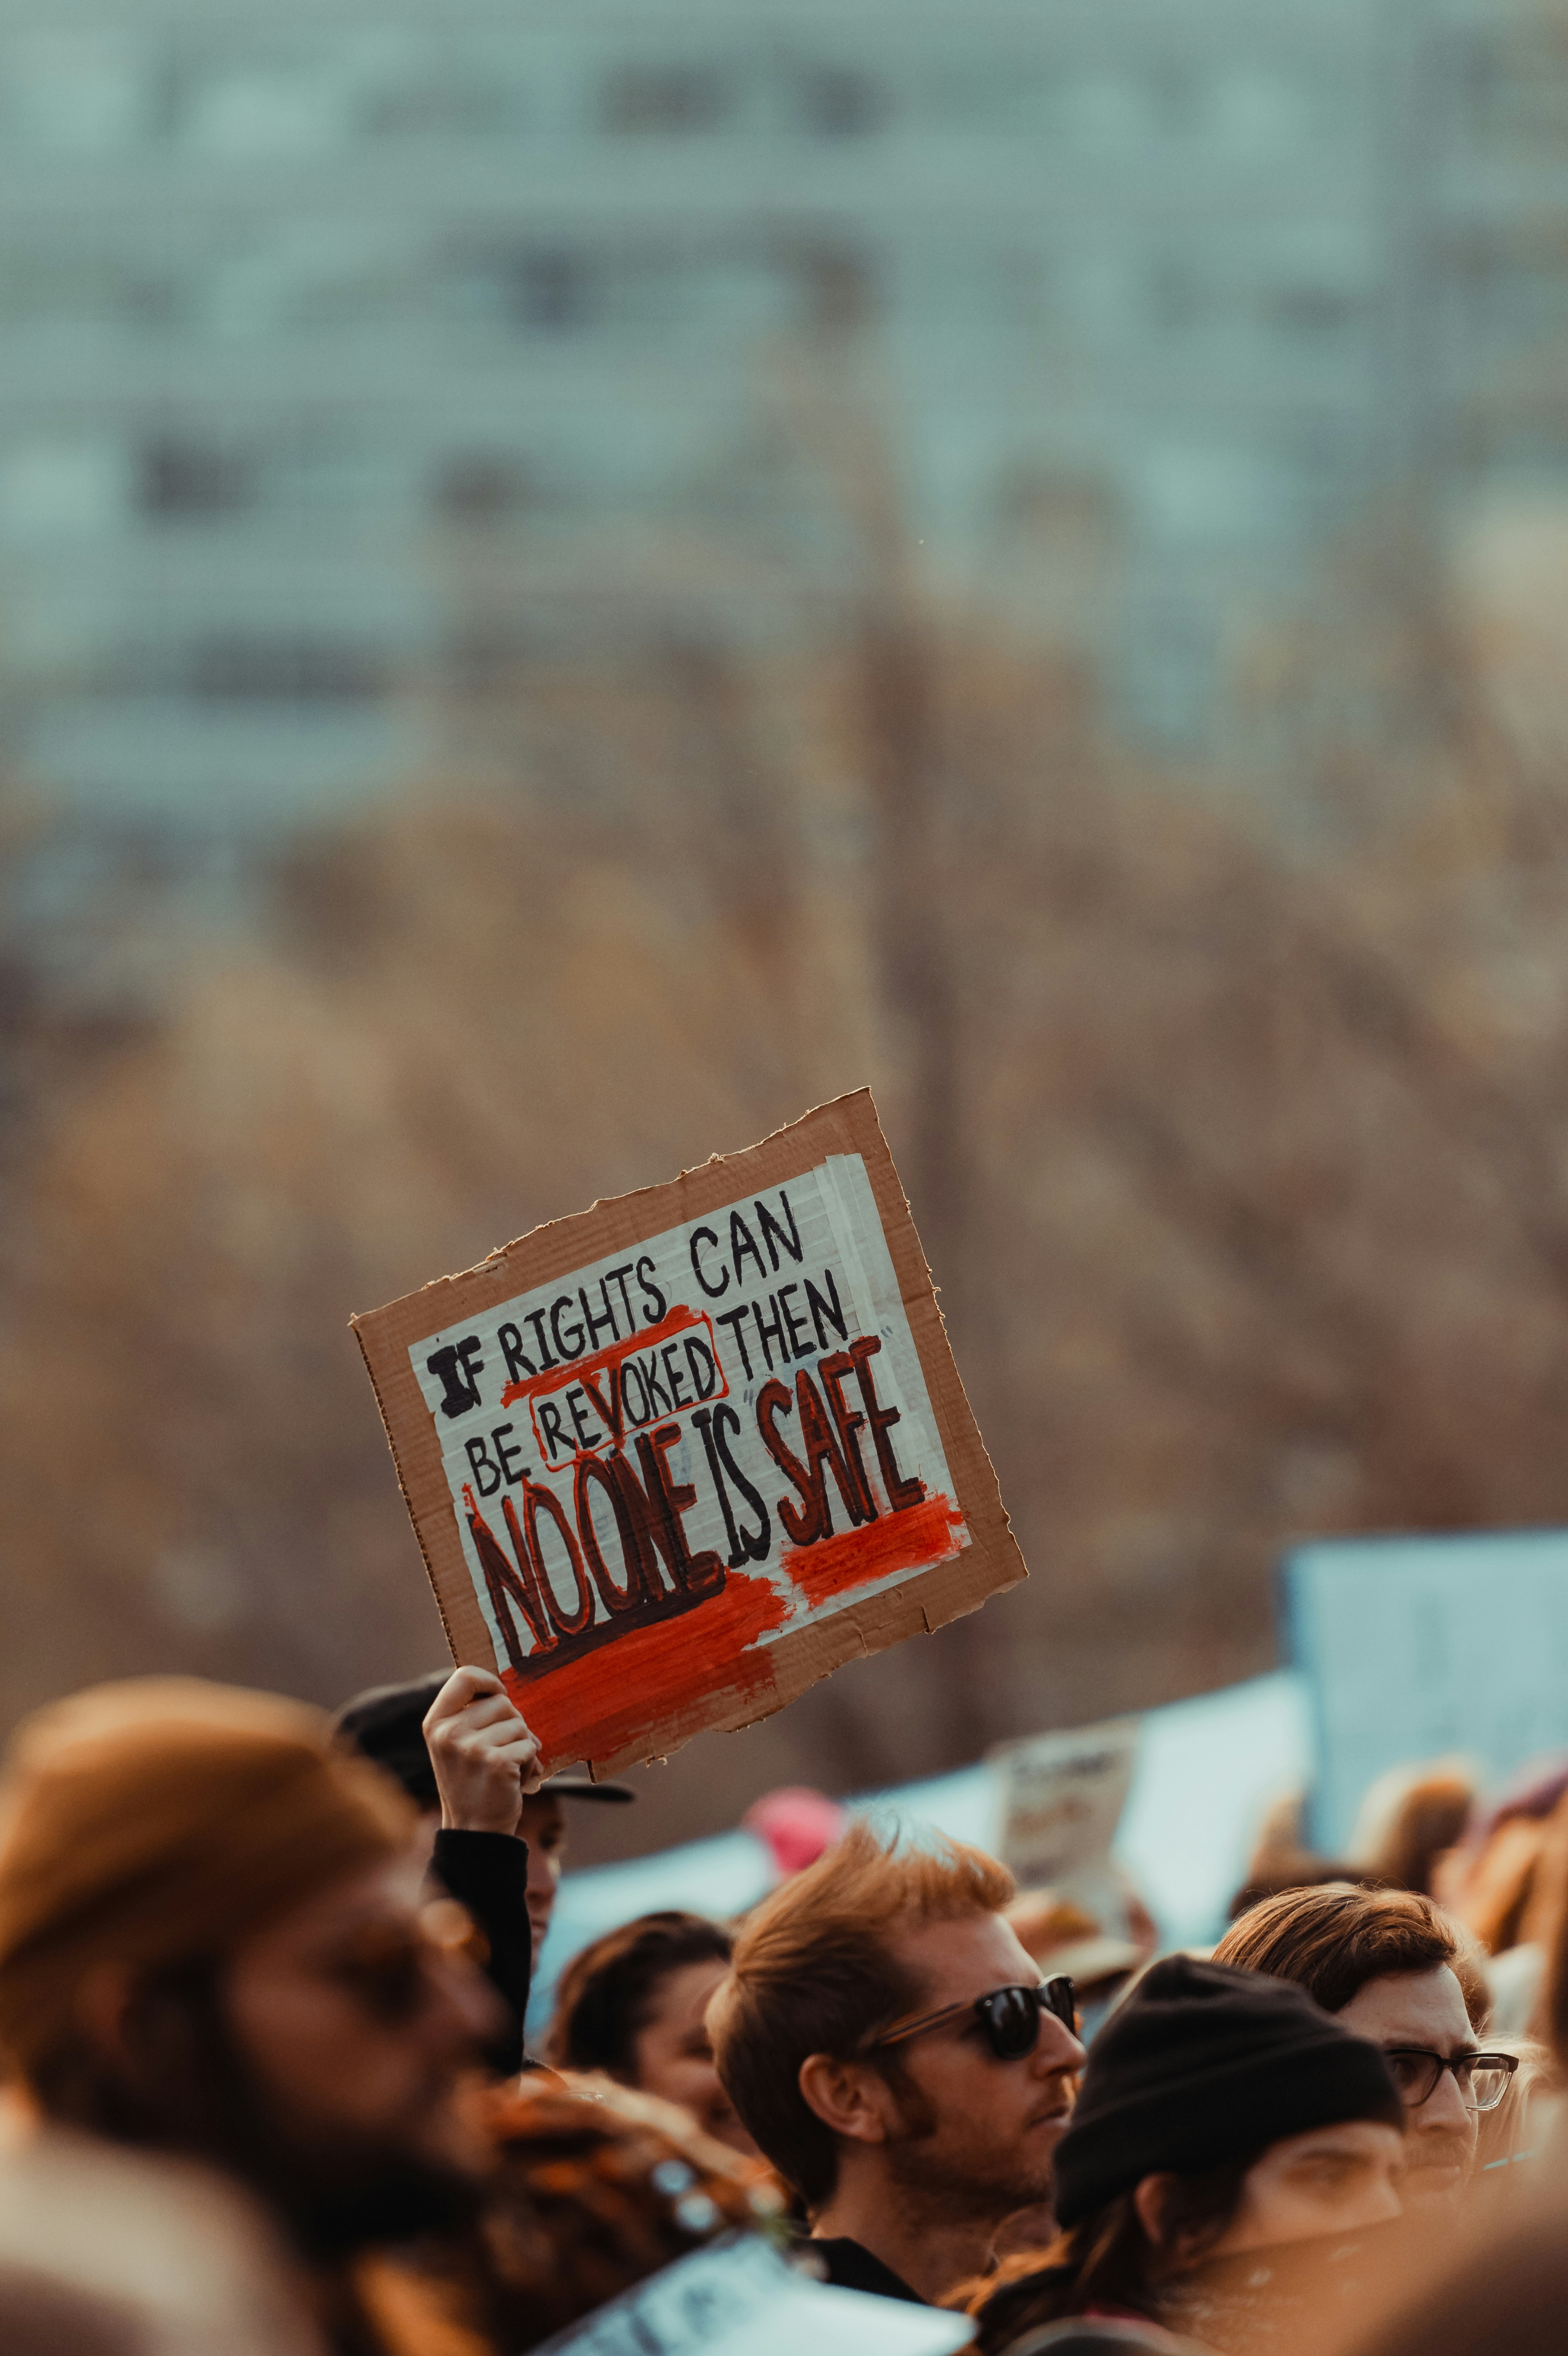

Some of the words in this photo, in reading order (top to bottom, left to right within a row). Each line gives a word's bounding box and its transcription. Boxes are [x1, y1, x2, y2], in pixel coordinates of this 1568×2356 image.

[427, 1335, 485, 1419] IF
[497, 1256, 666, 1384] RIGHTS
[690, 1191, 803, 1298] CAN
[465, 1423, 531, 1497] BE
[538, 1337, 716, 1459] REVOKED
[716, 1269, 848, 1381] THEN
[691, 1403, 771, 1569] IS
